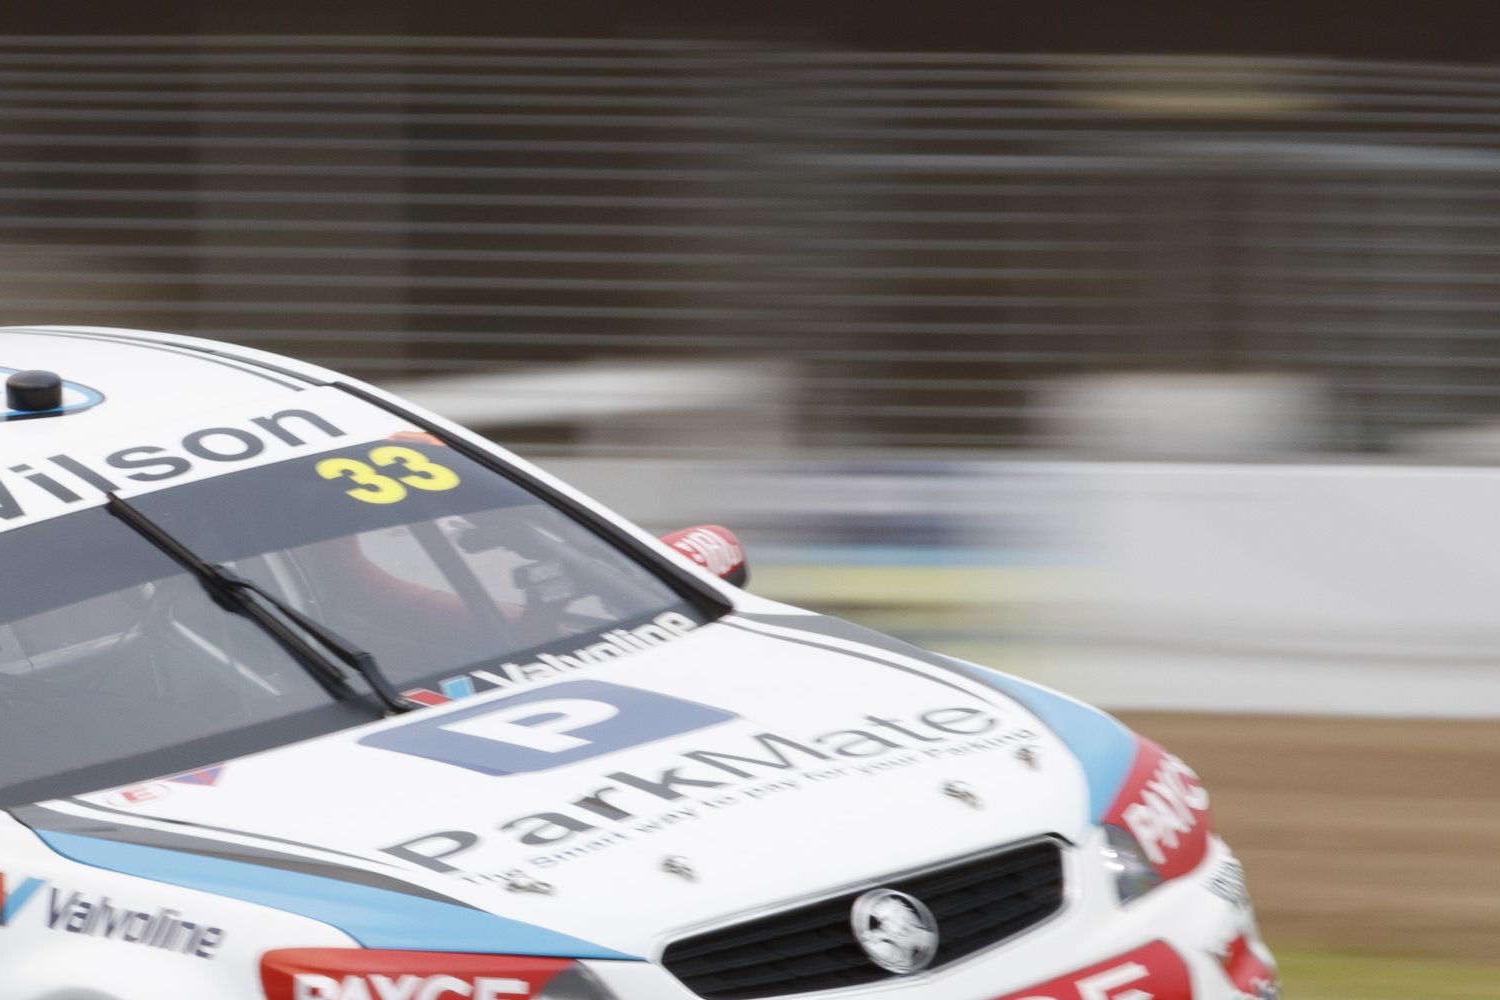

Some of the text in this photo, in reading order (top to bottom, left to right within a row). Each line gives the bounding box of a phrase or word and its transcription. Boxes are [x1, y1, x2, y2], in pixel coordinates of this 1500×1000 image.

[315, 446, 460, 504] 33
[470, 611, 698, 688] Valvoline
[438, 698, 620, 753] P
[380, 706, 998, 872] ParkMate
[49, 887, 224, 960] Valvoline
